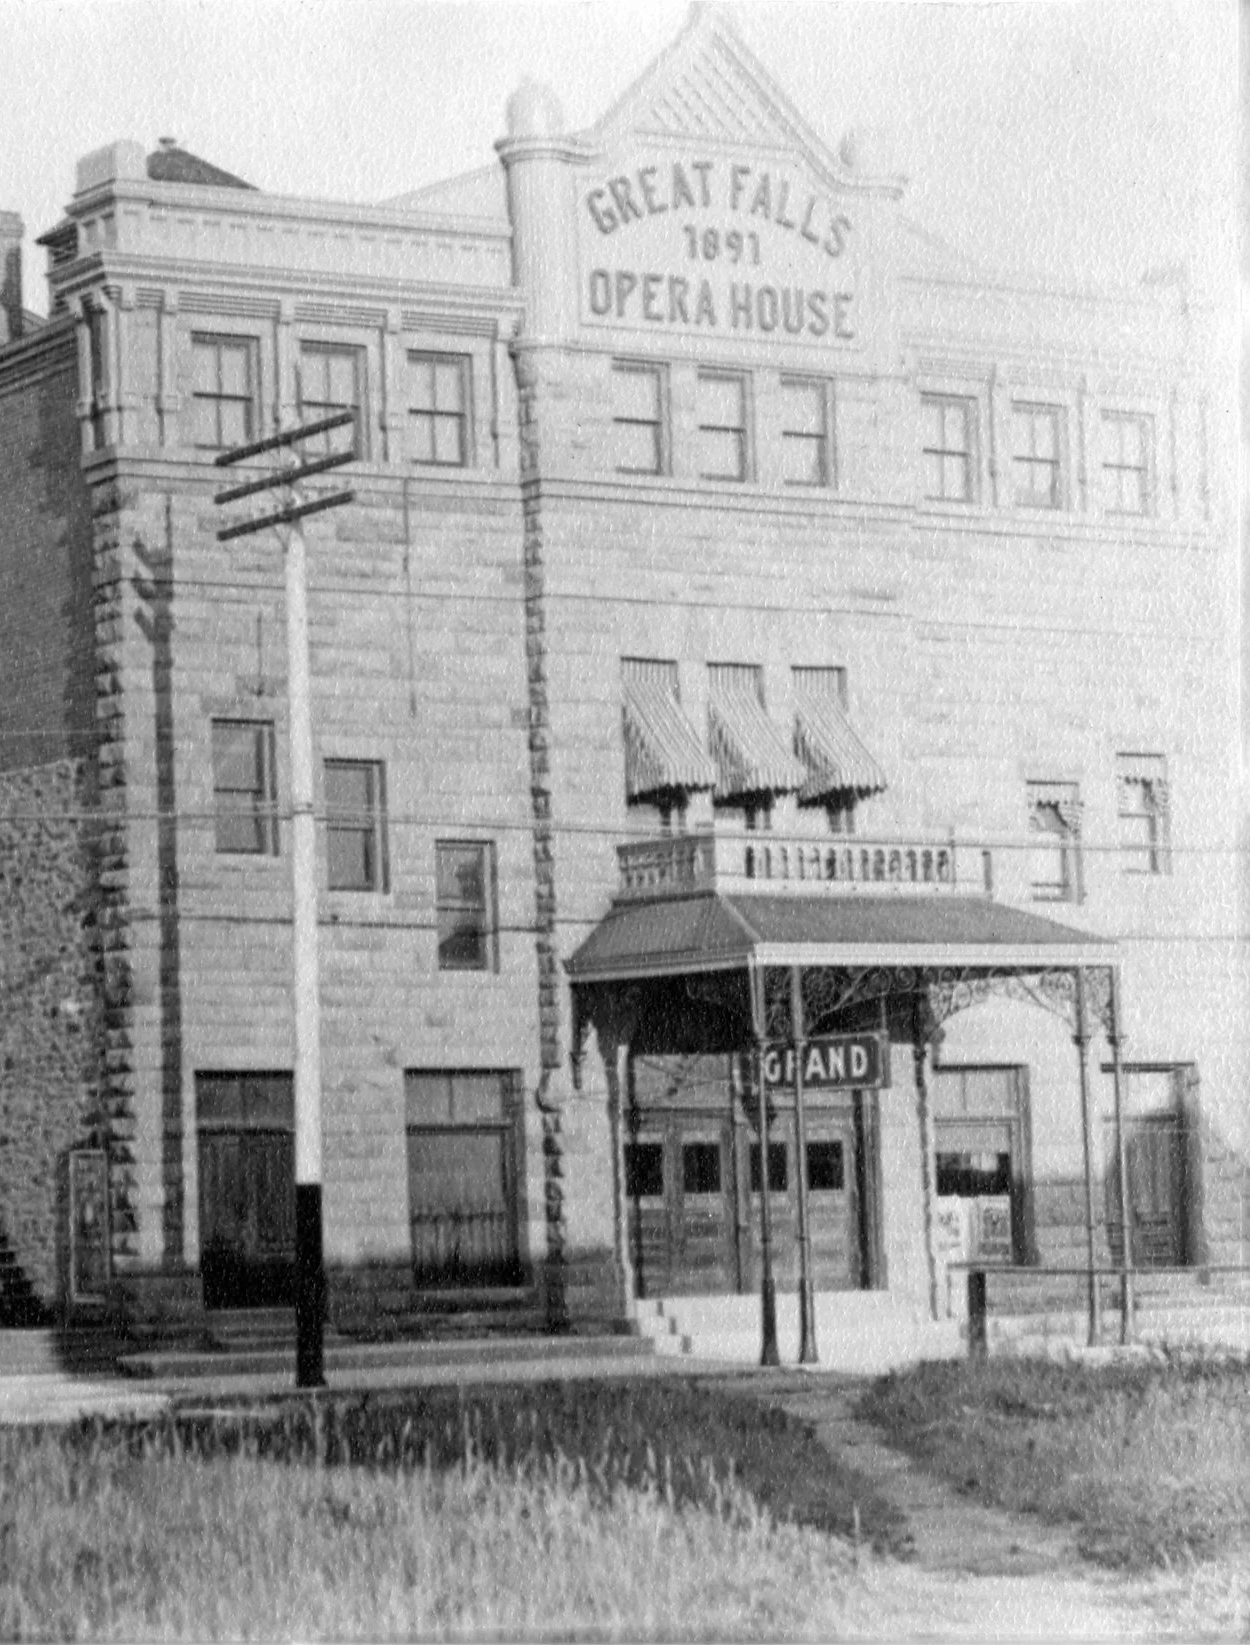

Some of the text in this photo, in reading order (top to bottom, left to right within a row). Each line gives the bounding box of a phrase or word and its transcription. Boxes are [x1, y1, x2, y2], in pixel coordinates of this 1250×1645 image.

[587, 161, 852, 258] GREAT FALLS
[683, 224, 761, 265] 1891
[588, 268, 854, 340] OPERA HOUSE
